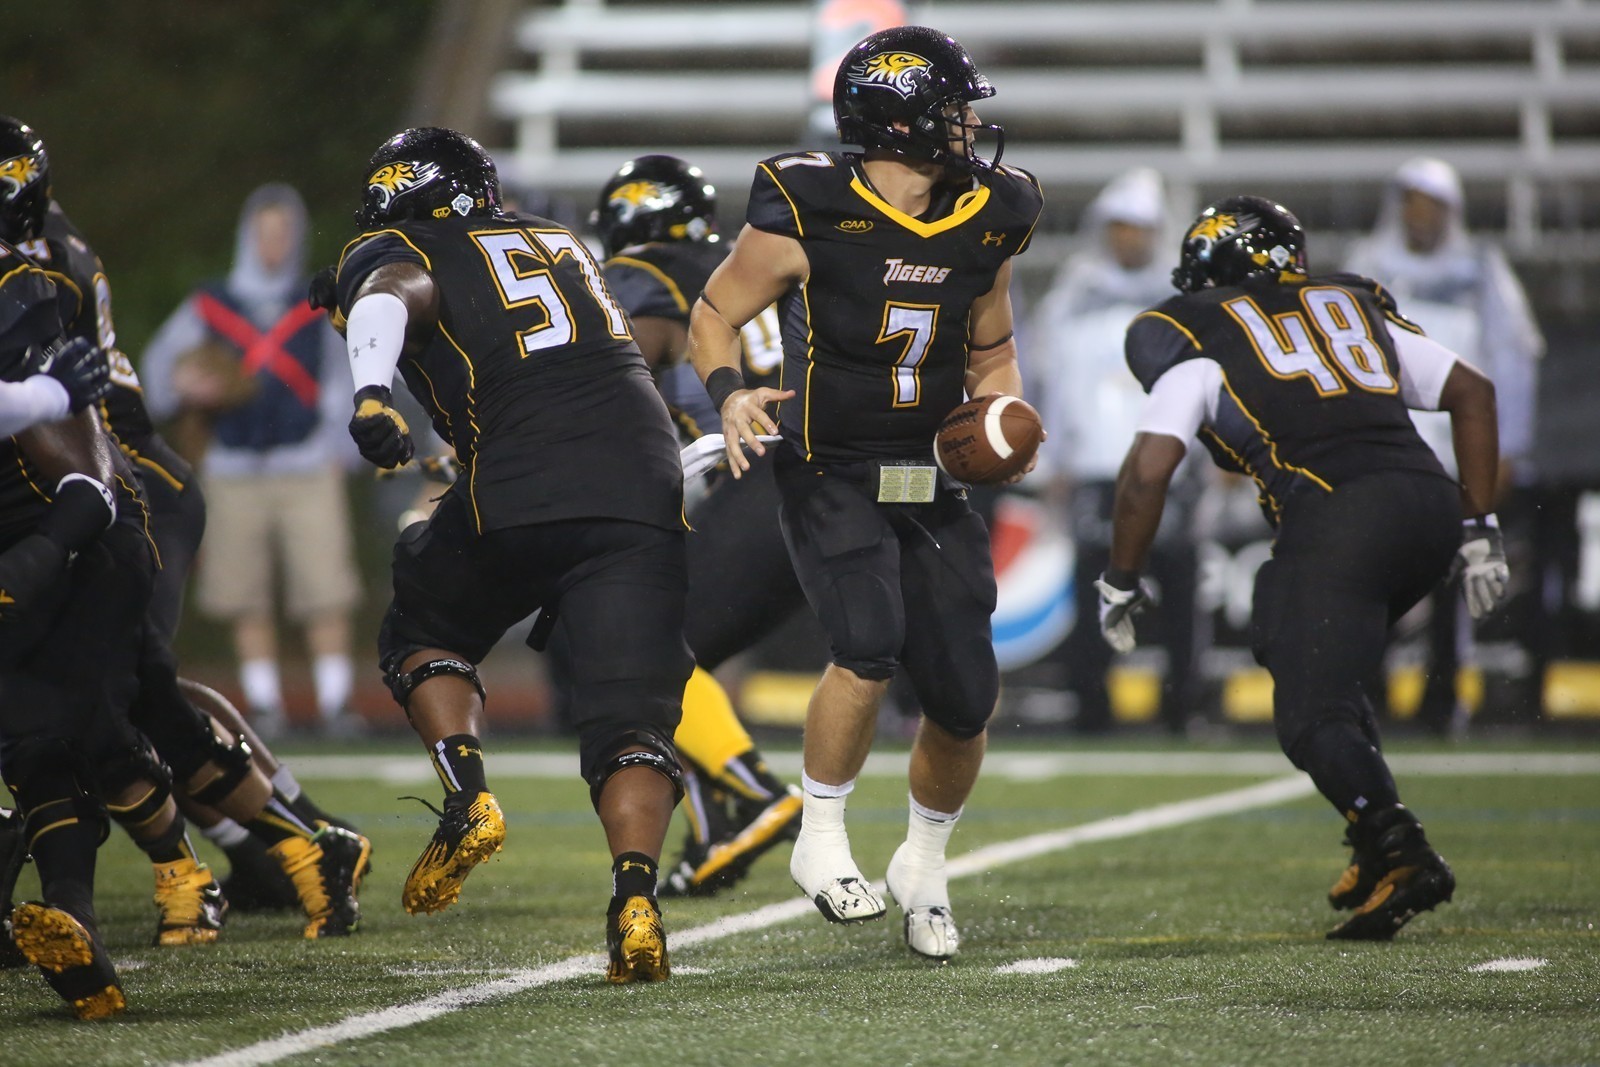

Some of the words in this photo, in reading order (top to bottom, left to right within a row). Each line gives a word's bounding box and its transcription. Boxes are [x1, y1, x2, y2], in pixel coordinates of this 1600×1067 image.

[840, 220, 867, 229] CAA
[468, 228, 633, 358] 57
[1221, 285, 1399, 398] 48
[875, 300, 940, 408] 7
